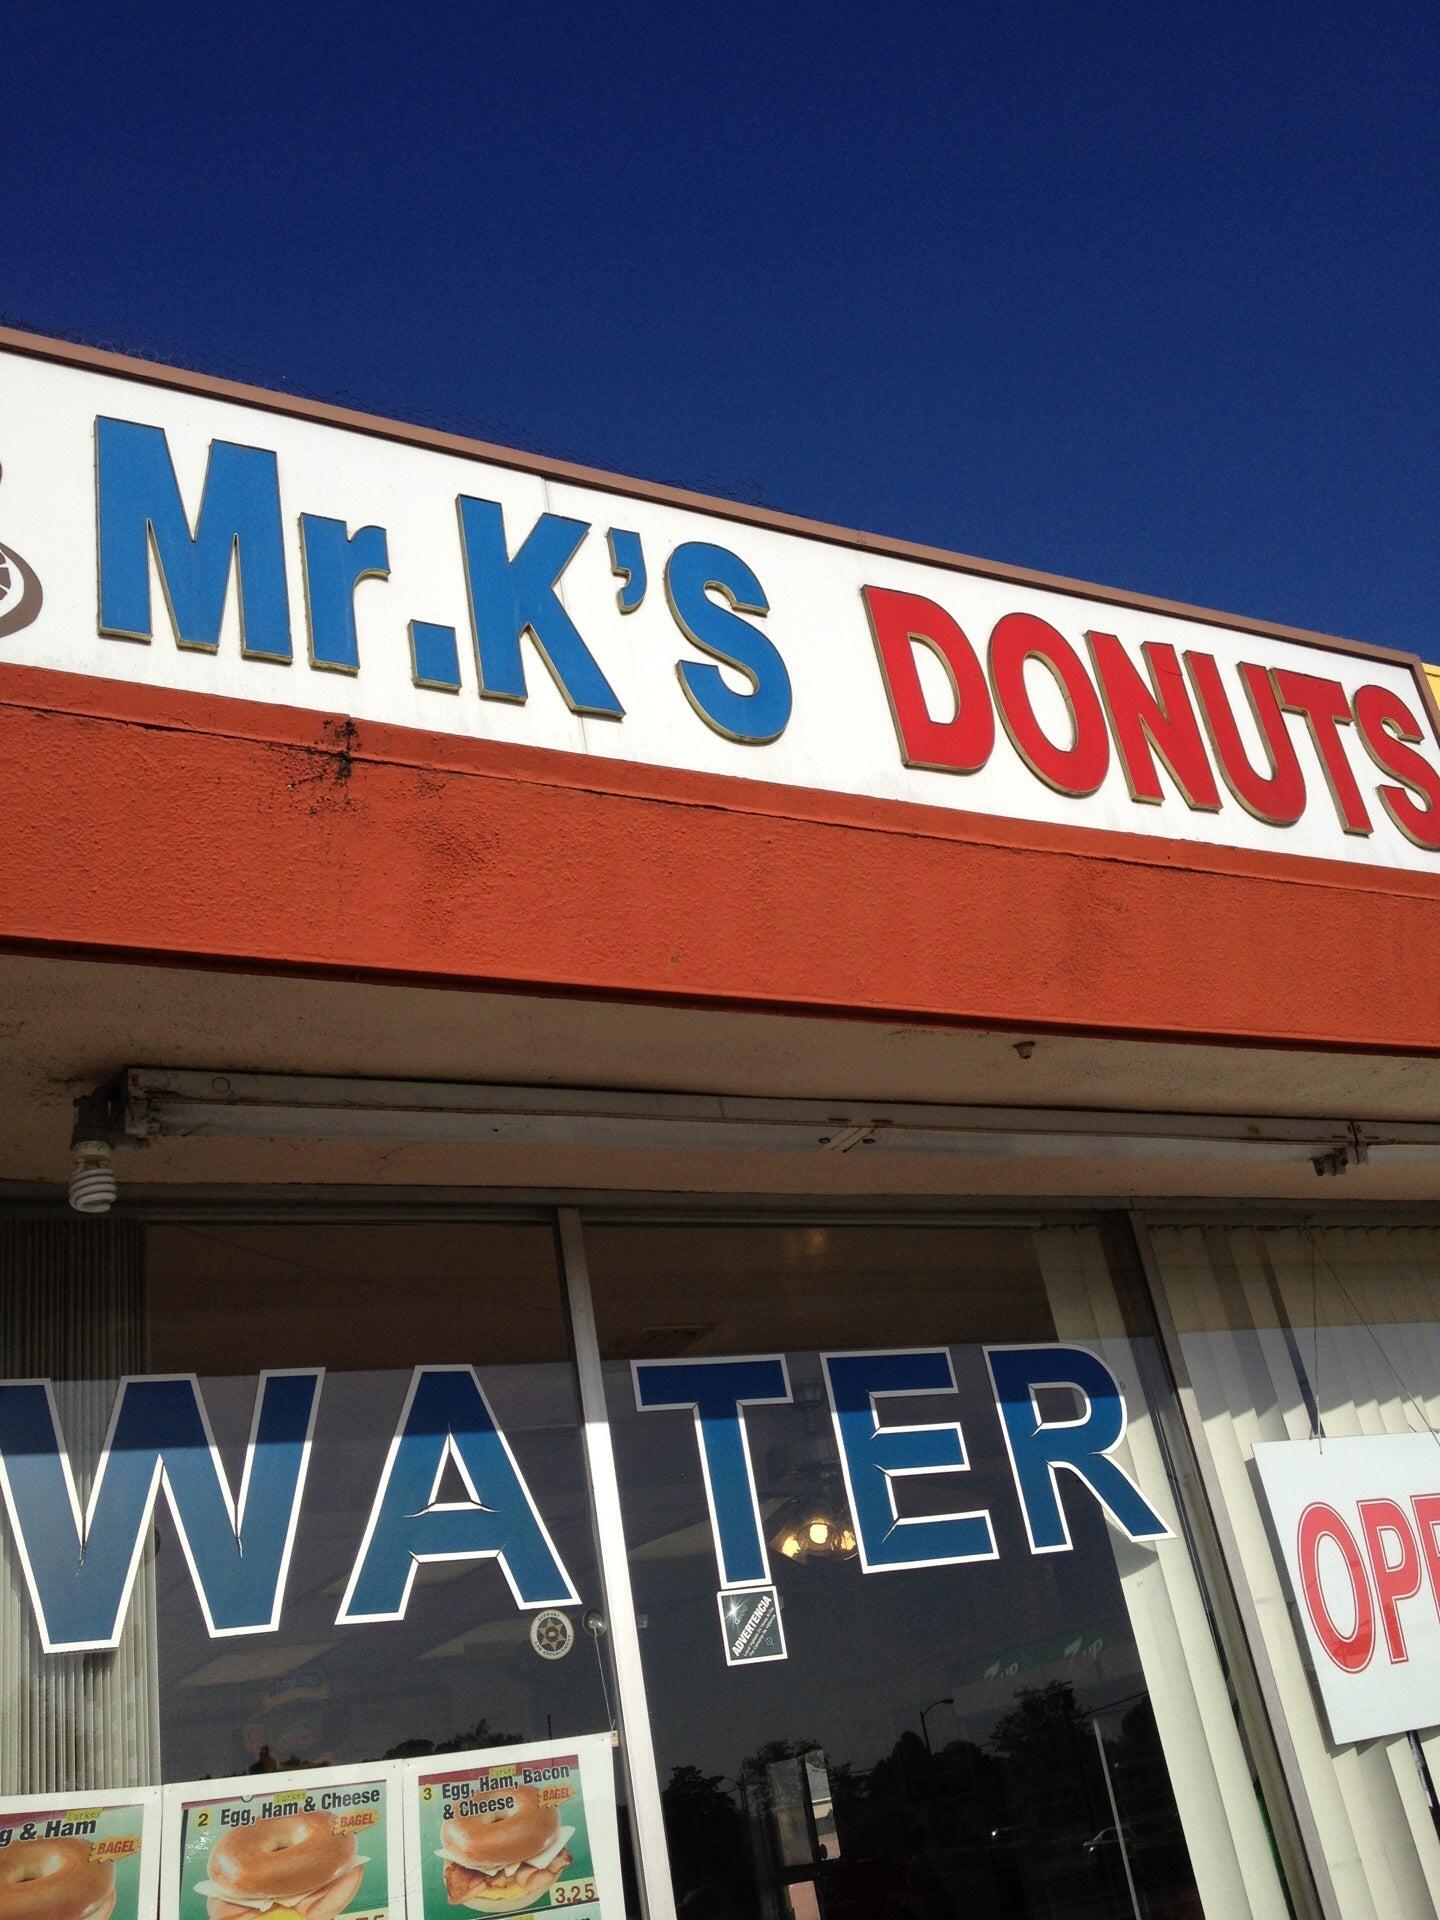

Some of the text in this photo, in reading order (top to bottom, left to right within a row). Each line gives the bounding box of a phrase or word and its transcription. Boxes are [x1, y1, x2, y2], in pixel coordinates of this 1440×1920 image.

[861, 584, 1440, 851] DONUTS
[0, 1344, 1178, 1653] WATER
[732, 1595, 772, 1657] ADVERTENCIA
[423, 1787, 432, 1800] 3
[442, 1765, 570, 1800] Egg, Ham, Bacon
[542, 1788, 571, 1801] BAGEL
[220, 1789, 380, 1828] Egg, Ham & Cheese
[339, 1812, 376, 1826] BAGEL
[443, 1796, 515, 1820] & Cheese
[19, 1822, 37, 1841] &
[44, 1819, 97, 1838] Ham
[198, 1814, 208, 1827] 2
[97, 1839, 135, 1855] BAGEL
[555, 1883, 596, 1904] 3.25
